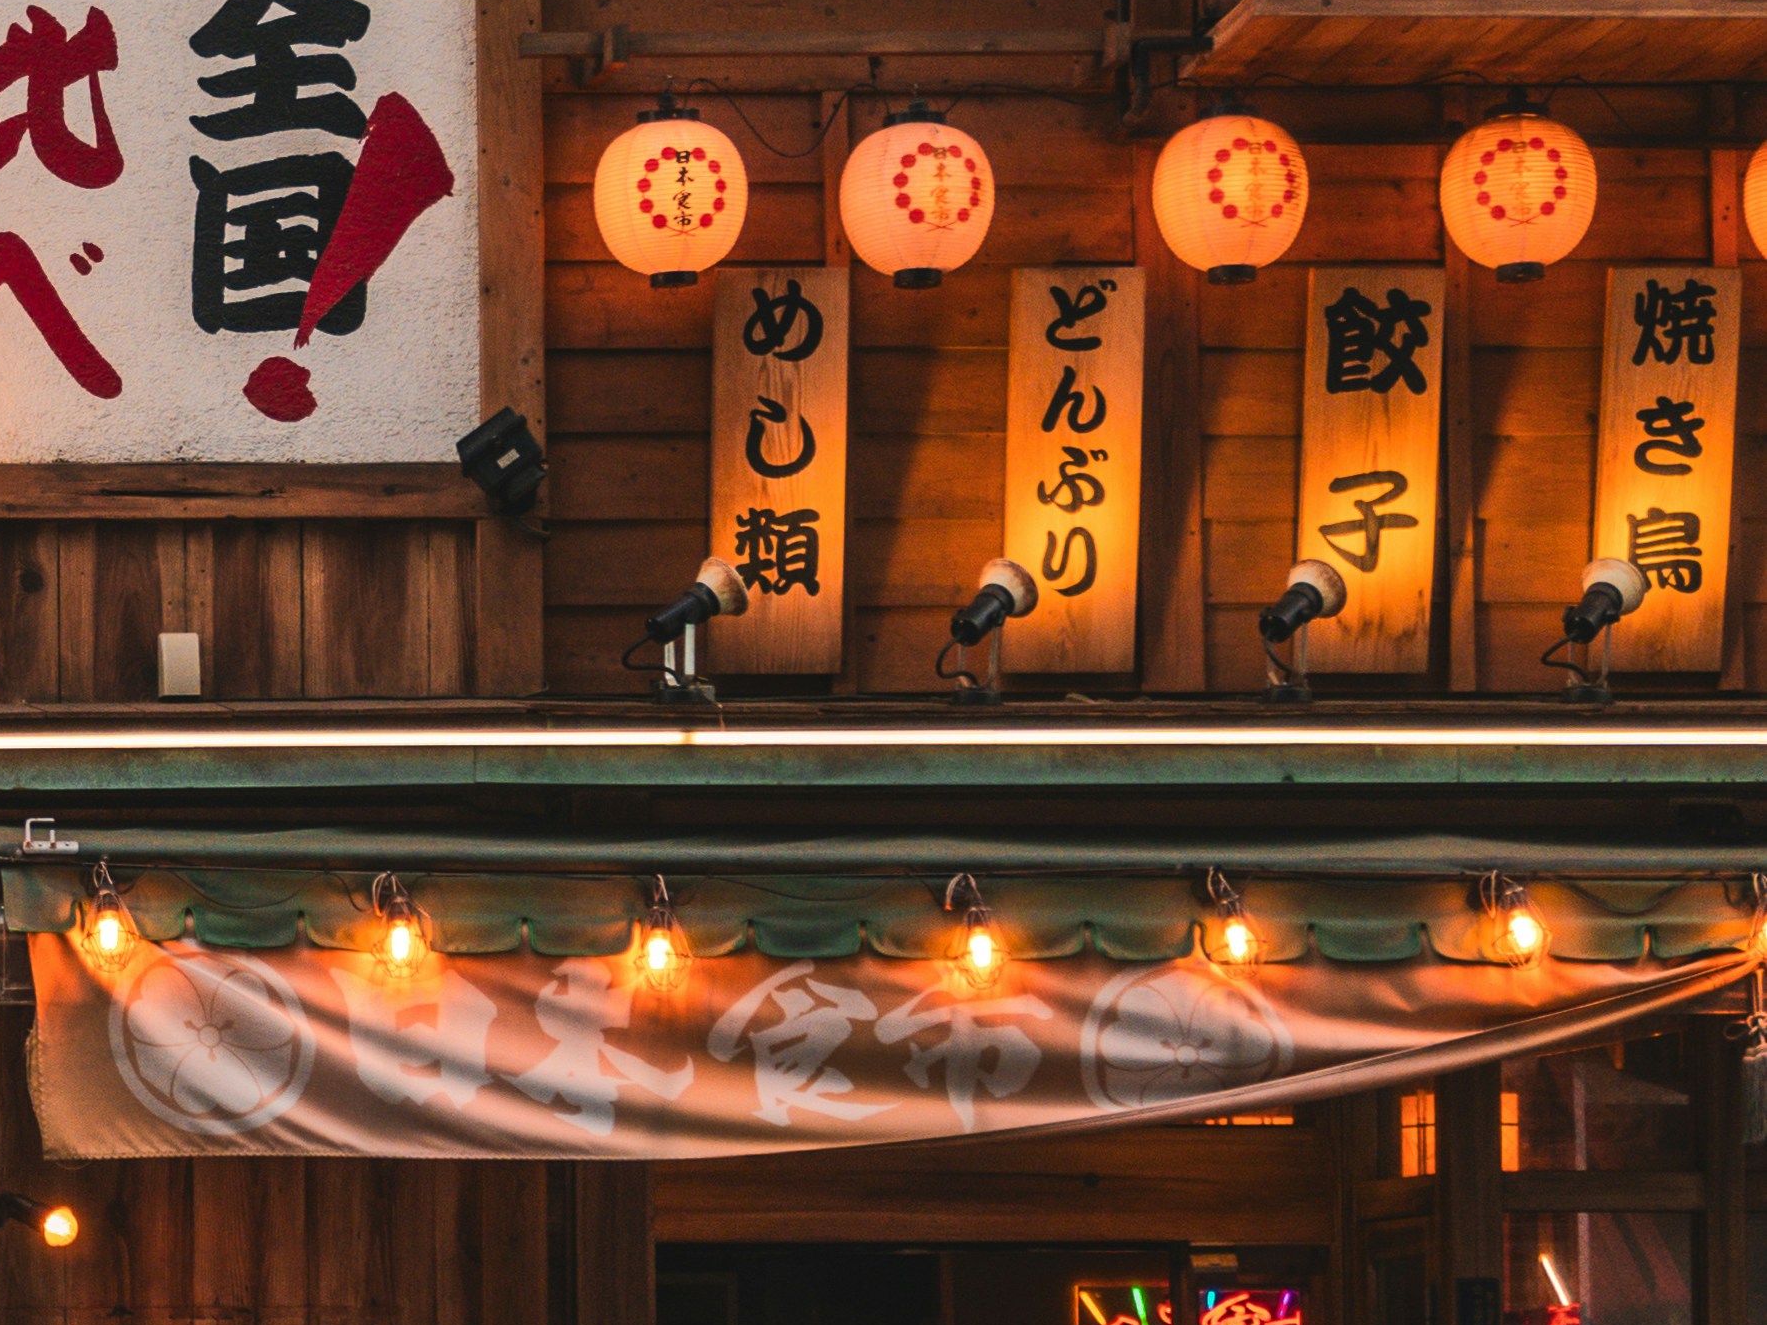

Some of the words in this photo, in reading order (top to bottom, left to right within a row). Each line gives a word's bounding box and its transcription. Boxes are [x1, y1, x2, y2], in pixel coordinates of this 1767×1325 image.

[672, 150, 695, 227] 日本食市
[929, 146, 951, 223] 日本食市
[733, 279, 824, 597] めし類
[1035, 278, 1117, 596] どんぶり
[1317, 286, 1429, 573] 餃子
[1625, 279, 1718, 594] 焼き鳥
[335, 958, 1055, 1134] 日本食市
